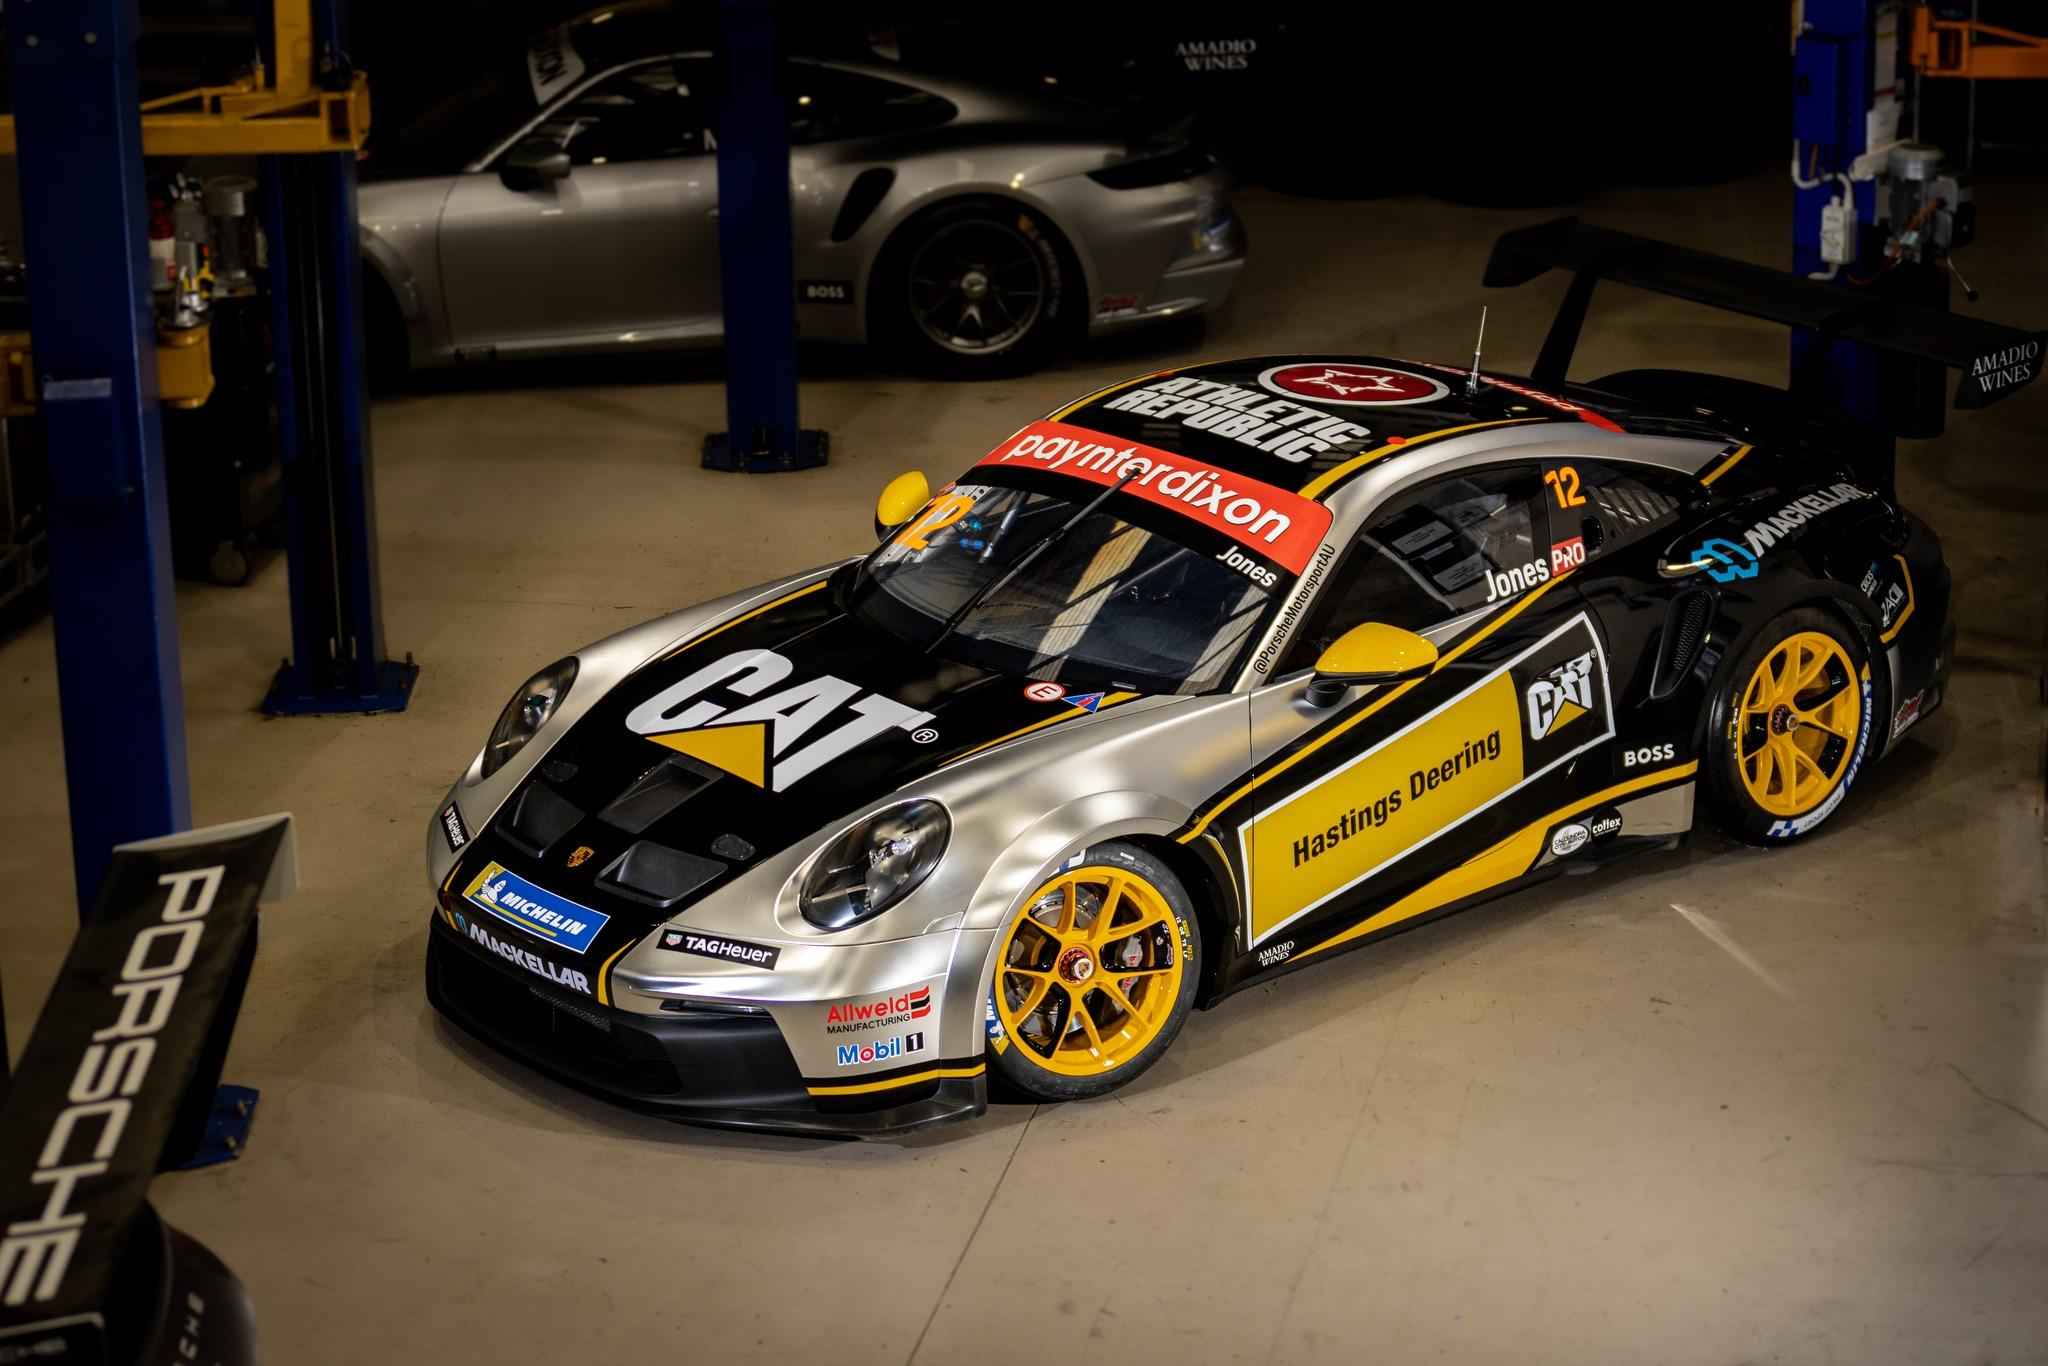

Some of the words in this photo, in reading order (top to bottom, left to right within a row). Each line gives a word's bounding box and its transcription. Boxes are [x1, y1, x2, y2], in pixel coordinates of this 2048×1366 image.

[1175, 38, 1257, 57] AMADIO
[1184, 54, 1249, 72] WINES
[806, 284, 845, 299] BOSS
[1972, 341, 2038, 376] AMADIO
[1979, 362, 2031, 393] WINES
[1103, 386, 1335, 464] REPUBLIC
[1139, 376, 1371, 448] ATHLETIC
[1000, 433, 1292, 544] paynterdixon
[1544, 466, 1587, 509] 12
[1744, 483, 1869, 559] MACKELLAR
[1215, 545, 1278, 588] Jones
[1551, 541, 1586, 573] PRO
[1486, 558, 1550, 602] Jones
[1253, 543, 1336, 675] @PorscheMotorsportAU
[1527, 652, 1593, 740] CAT
[625, 648, 938, 793] CAT
[1624, 743, 1675, 767] BOSS
[1847, 701, 1873, 787] MICHELIN
[1293, 788, 1402, 868] Hastings
[1409, 739, 1502, 801] Deering
[500, 891, 587, 936] MICHELIN
[469, 922, 592, 995] MACKELLAR
[1258, 940, 1295, 962] AMADIO
[1262, 950, 1290, 967] WINES
[827, 993, 909, 1024] Allweld
[827, 1013, 911, 1034] MANUFACTURING
[837, 1036, 901, 1066] Mobil
[0, 864, 226, 1305] PORSCHE
